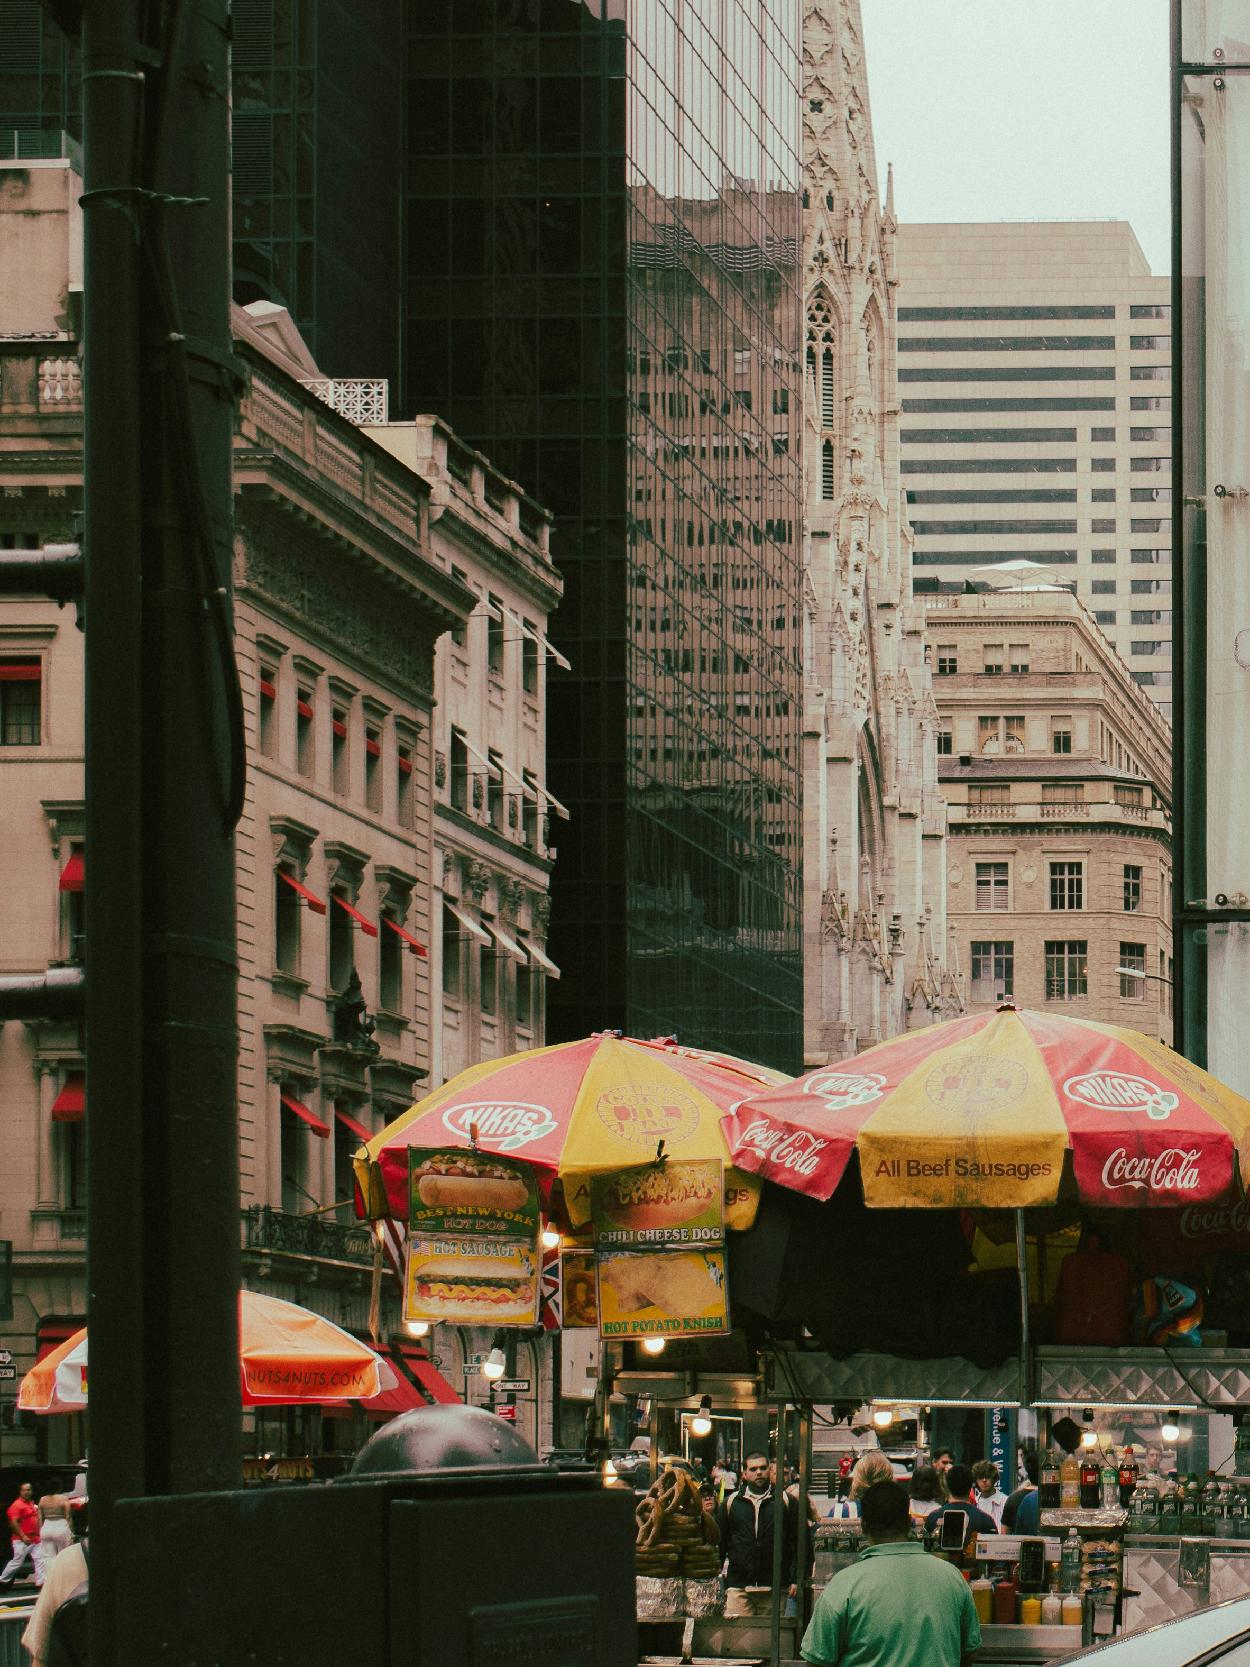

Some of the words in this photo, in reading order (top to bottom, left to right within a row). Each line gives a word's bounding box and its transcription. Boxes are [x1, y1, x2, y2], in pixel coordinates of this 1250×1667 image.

[1076, 1077, 1151, 1105] NIKAS
[458, 1106, 539, 1135] NIKAS
[735, 1119, 830, 1176] Coca-Cola
[875, 1159, 900, 1177] All
[906, 1158, 951, 1177] Beef
[954, 1158, 1052, 1181] Sausages
[1102, 1147, 1203, 1189] Coca-Cola
[416, 1206, 453, 1220] BEST
[456, 1206, 492, 1217] NEW
[495, 1208, 535, 1227] YORK
[600, 1231, 634, 1244] CHILI
[637, 1228, 689, 1243] CHEESE
[692, 1227, 721, 1241] DOG
[434, 1240, 458, 1255] HOT
[460, 1241, 515, 1257] SAUSAGE
[603, 1321, 629, 1334] HOT
[632, 1318, 681, 1332] POTATO
[683, 1316, 723, 1330] KNISH
[247, 1370, 366, 1386] NUTS4NUTS.COM
[992, 1408, 1001, 1445] venue
